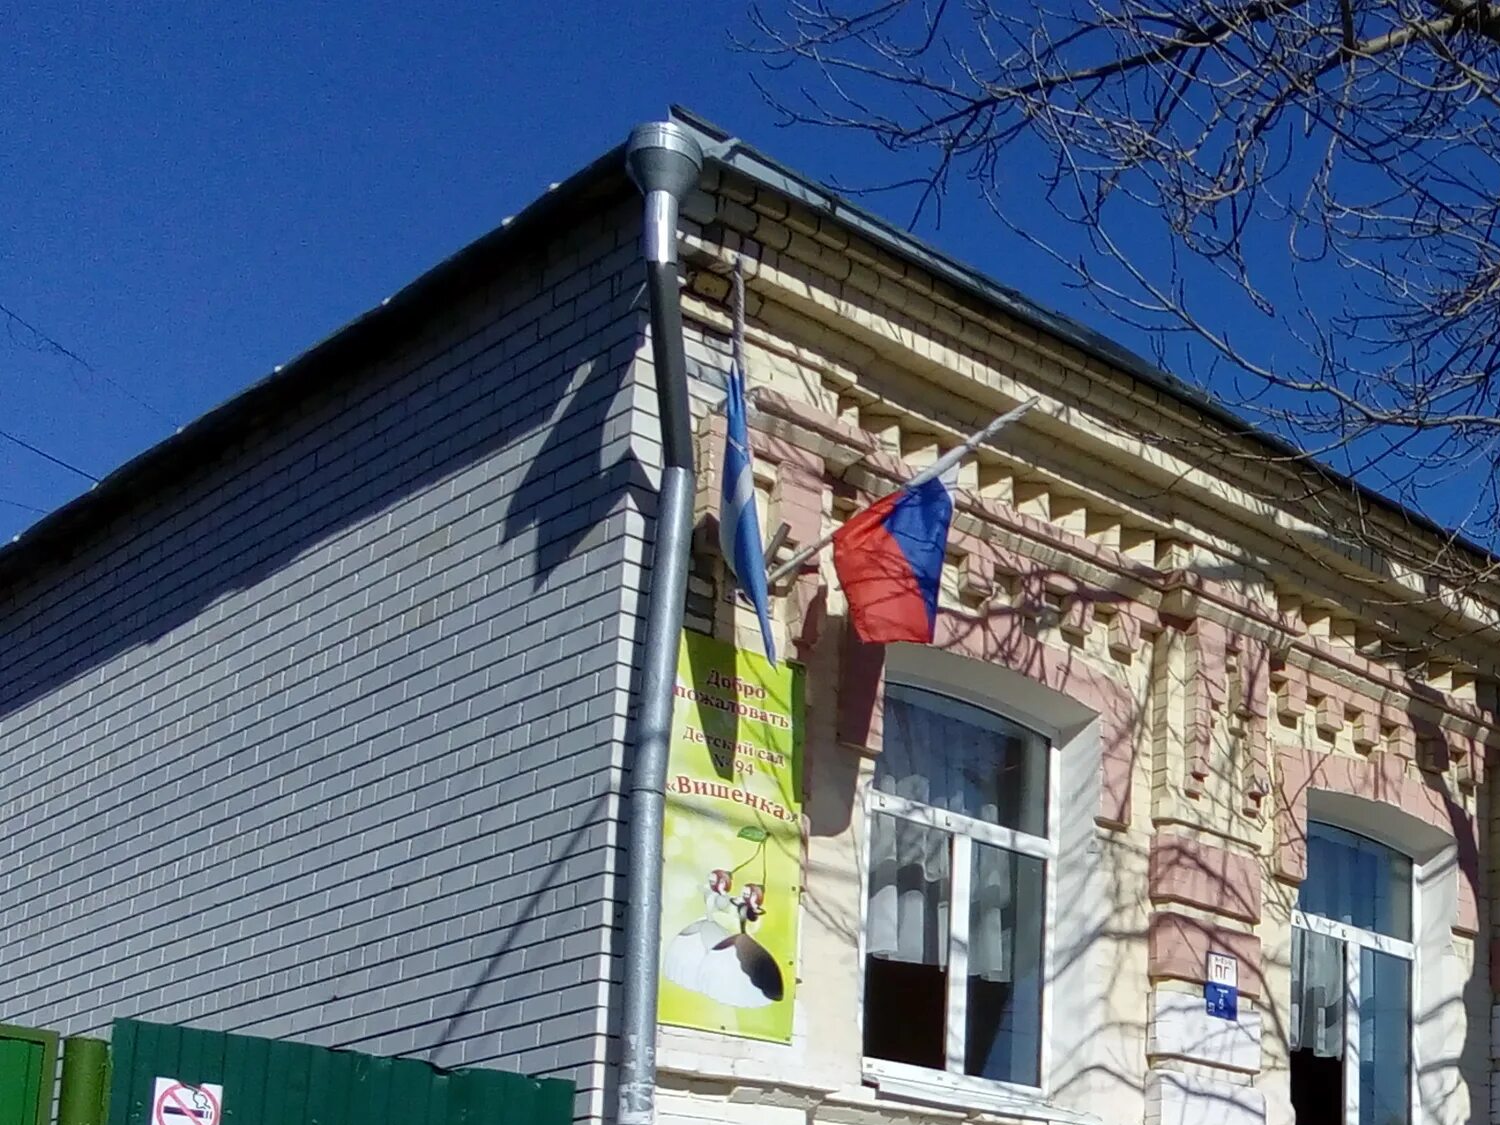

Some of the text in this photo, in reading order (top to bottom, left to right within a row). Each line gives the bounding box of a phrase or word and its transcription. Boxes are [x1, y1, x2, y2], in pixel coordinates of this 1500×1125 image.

[706, 669, 766, 699] Добро
[673, 684, 789, 728] пожаловать
[683, 726, 784, 767] Детский сад
